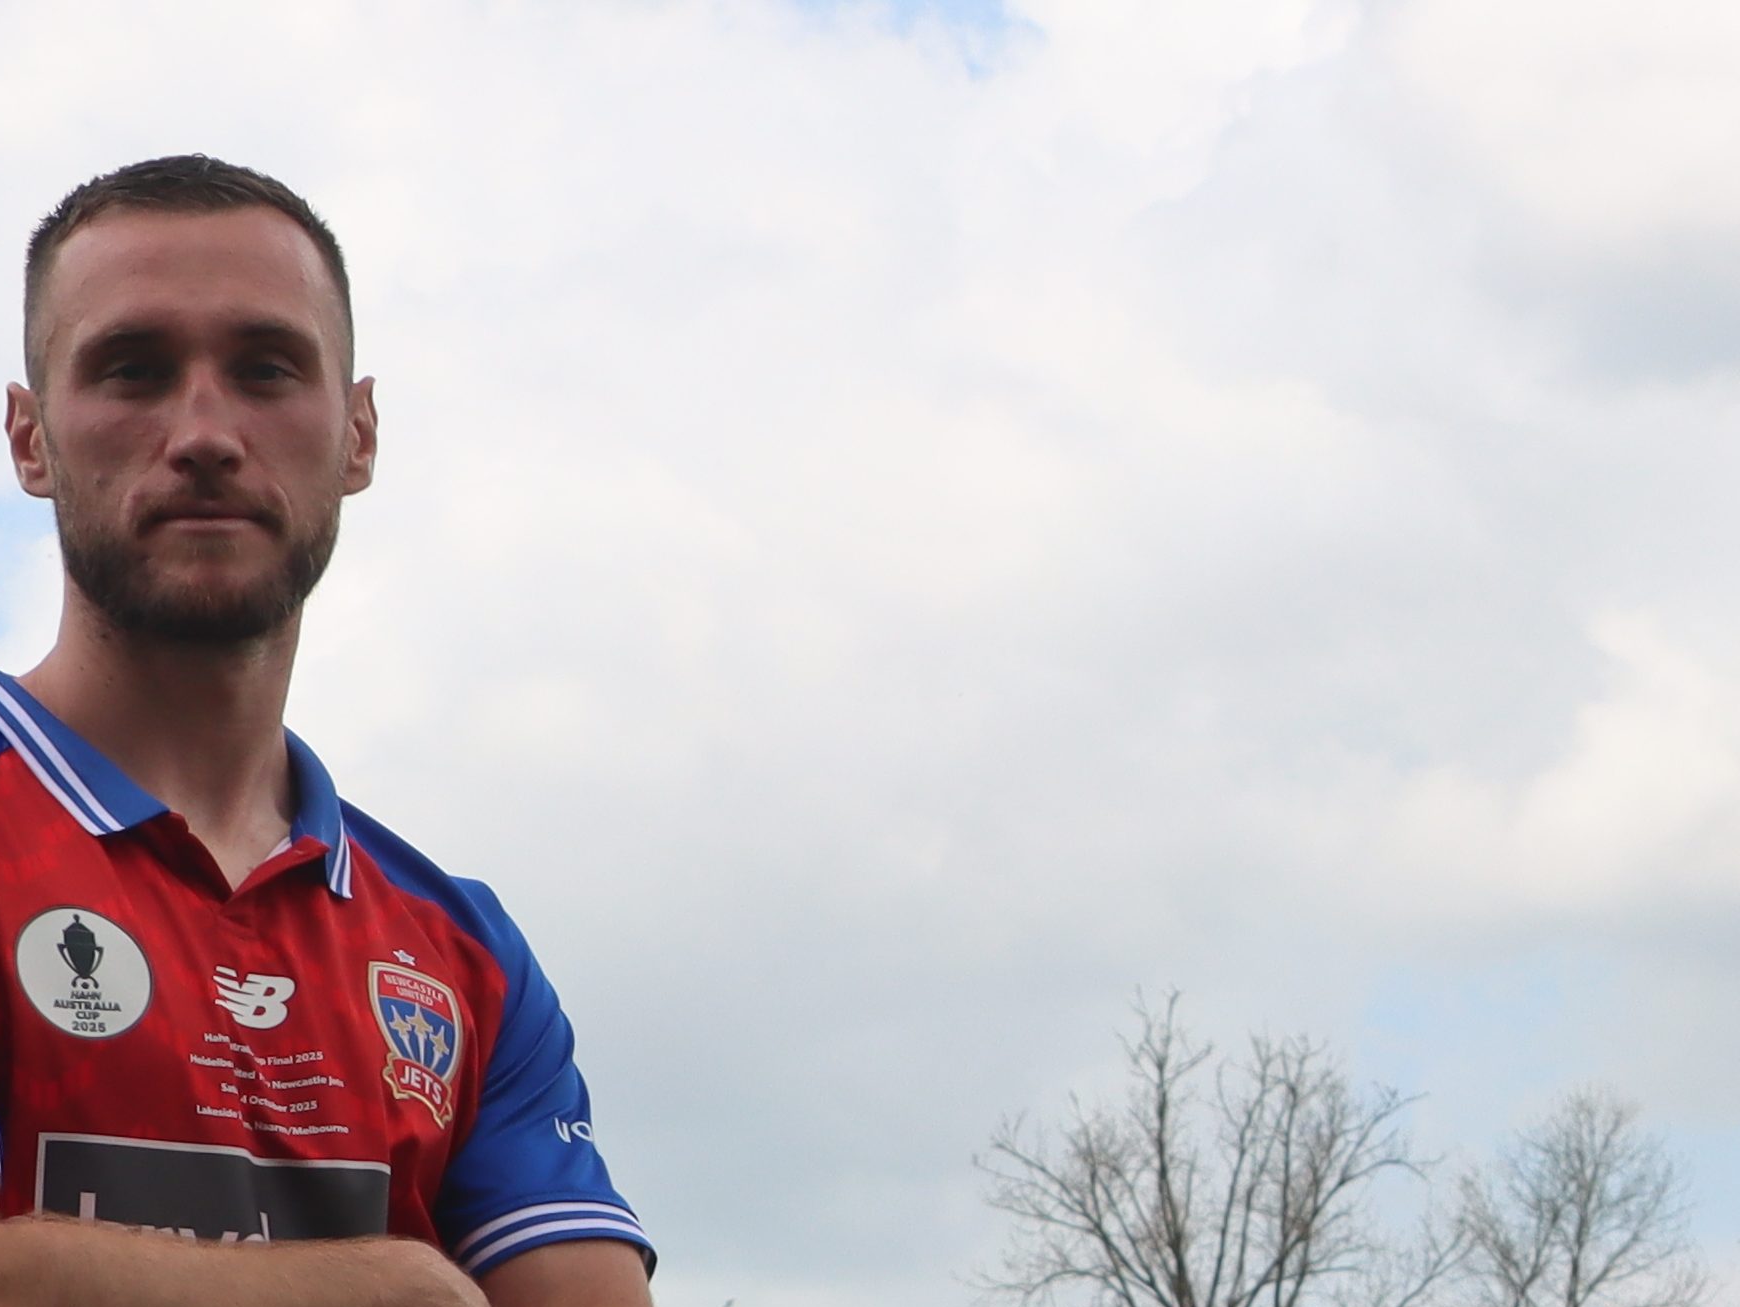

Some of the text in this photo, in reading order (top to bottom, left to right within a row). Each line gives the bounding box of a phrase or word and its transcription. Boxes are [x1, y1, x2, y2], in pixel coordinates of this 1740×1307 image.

[383, 973, 444, 1003] NEWCASTLE
[396, 986, 434, 1007] UNITED
[53, 999, 121, 1012] AUSTRALIA
[75, 1011, 100, 1020] CUP
[72, 1021, 106, 1033] 2025
[267, 1055, 293, 1066] Final
[295, 1051, 324, 1064] 2025
[272, 1076, 327, 1090] Newcastle
[400, 1066, 443, 1105] JETS
[289, 1100, 318, 1114] 2025
